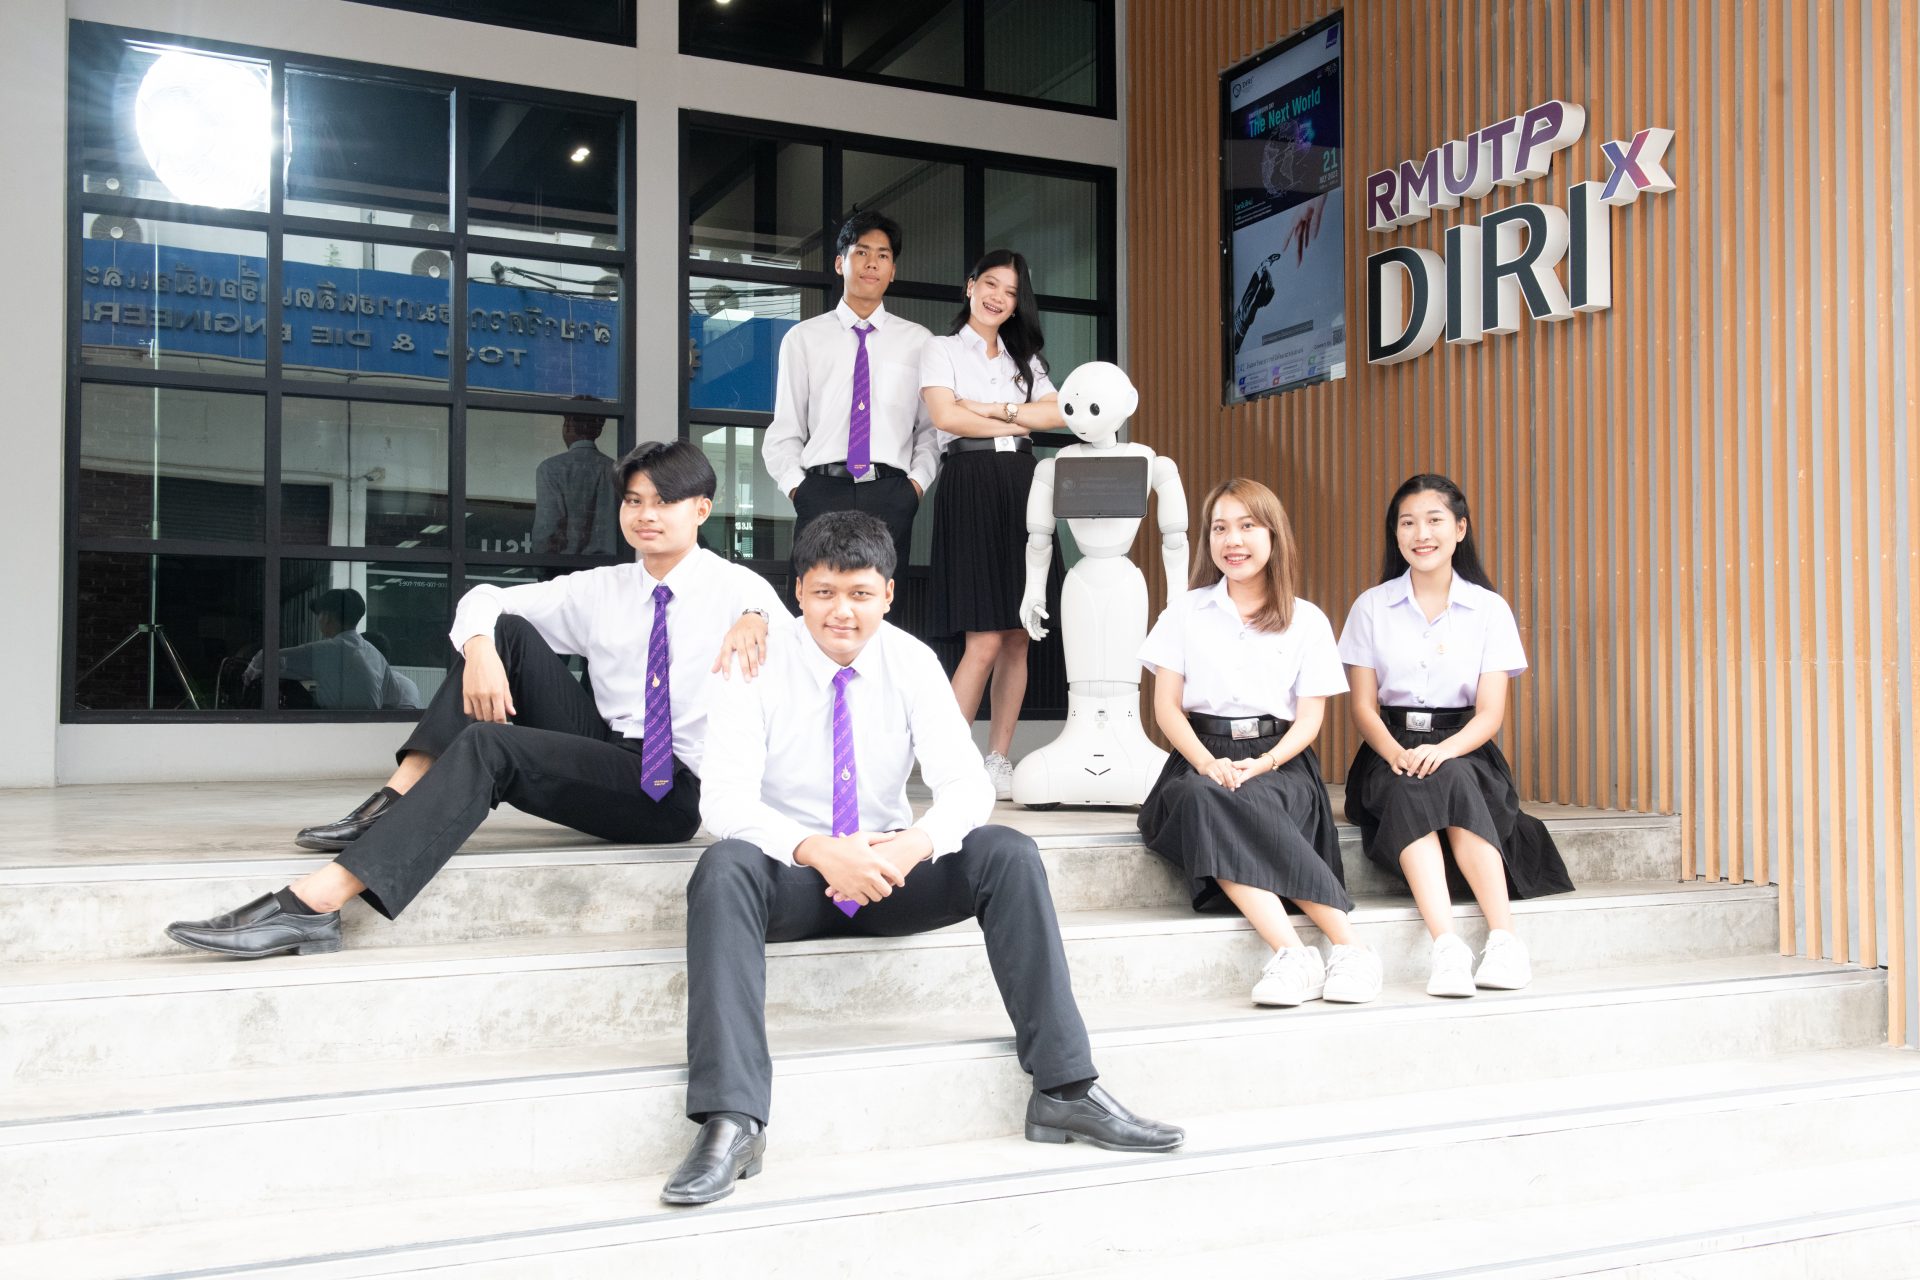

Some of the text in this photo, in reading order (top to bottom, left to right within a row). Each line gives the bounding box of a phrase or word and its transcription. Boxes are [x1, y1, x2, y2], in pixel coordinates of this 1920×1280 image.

[1248, 117, 1266, 137] The
[1268, 102, 1290, 128] Next
[1292, 86, 1321, 116] World
[1323, 146, 1338, 173] 21
[1367, 100, 1575, 232] RMUTP
